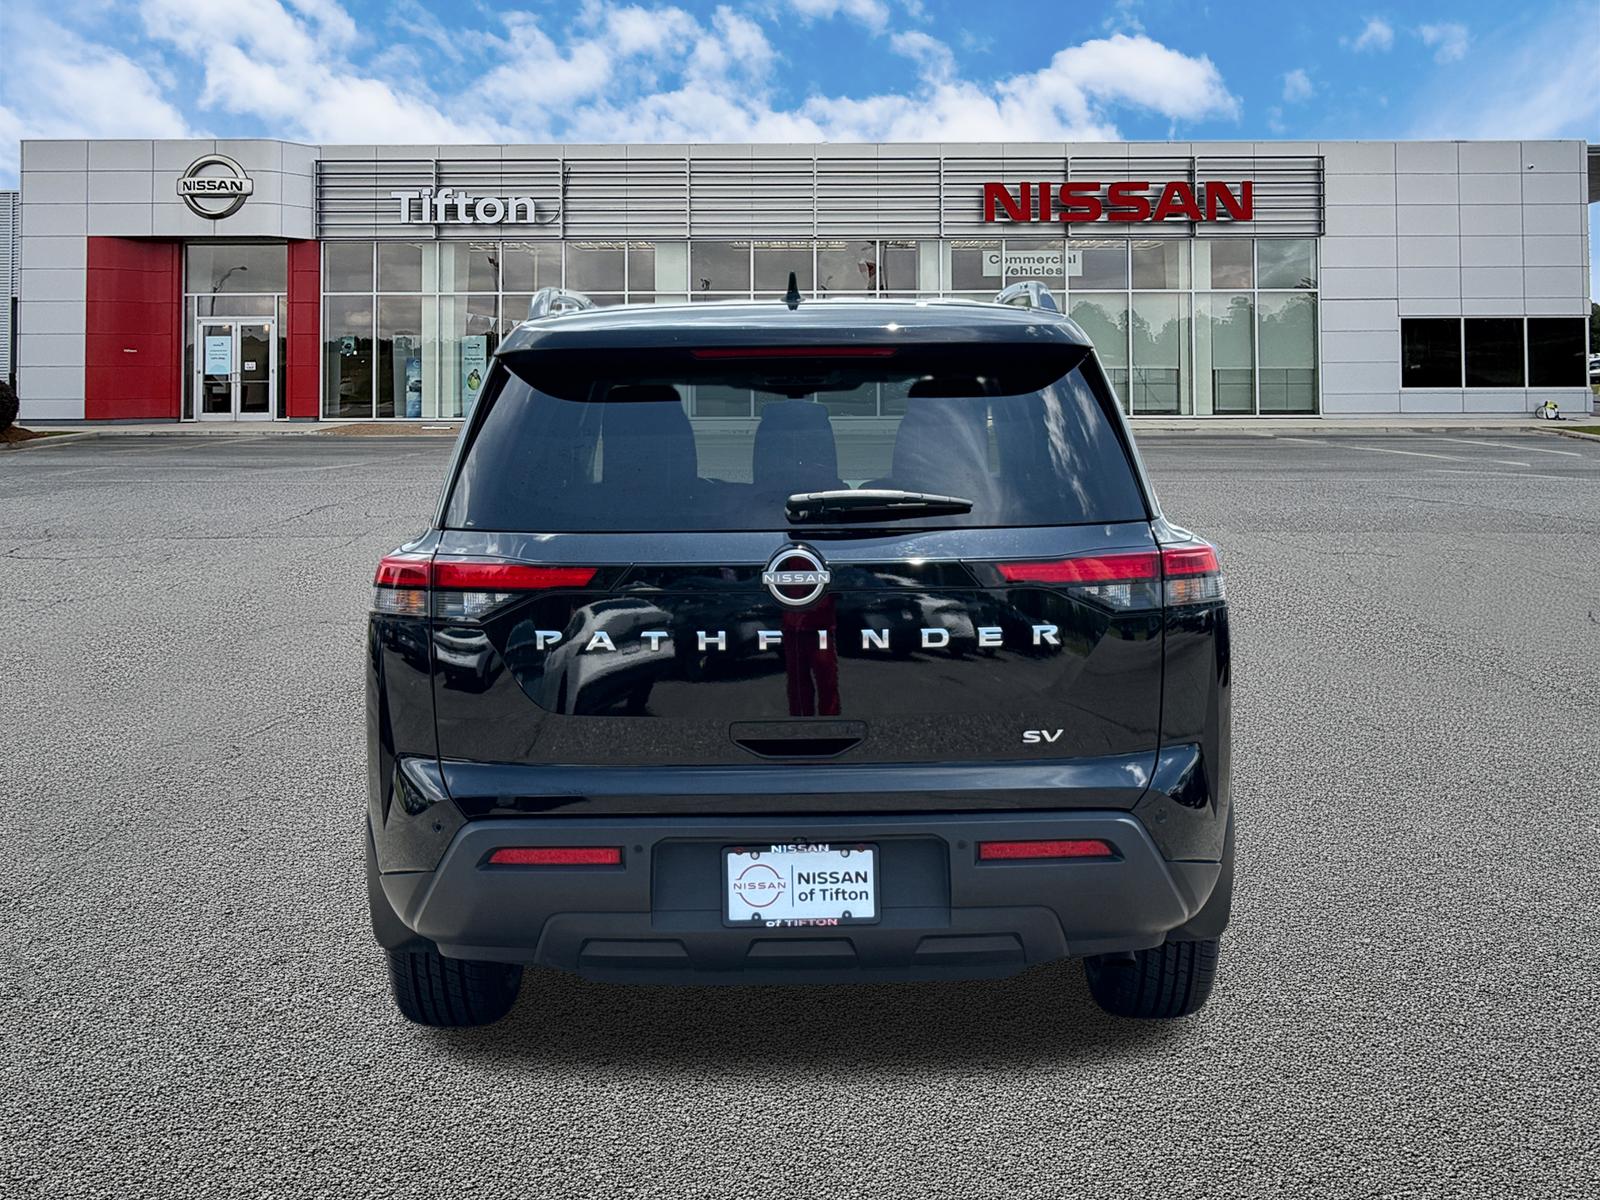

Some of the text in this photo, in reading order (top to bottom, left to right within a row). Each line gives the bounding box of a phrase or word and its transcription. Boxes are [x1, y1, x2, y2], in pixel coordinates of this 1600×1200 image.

[183, 180, 243, 191] NISSAN
[391, 188, 536, 224] Tifton
[984, 181, 1253, 222] NISSAN
[764, 574, 828, 583] NISSAN
[535, 624, 1061, 651] PATHFINDER
[1022, 729, 1064, 743] SV
[771, 844, 830, 853] NISSAN
[797, 871, 868, 885] NISSAN
[733, 882, 787, 890] NISSAN
[798, 888, 869, 902] of Tifton
[766, 918, 838, 928] of TIFTON
